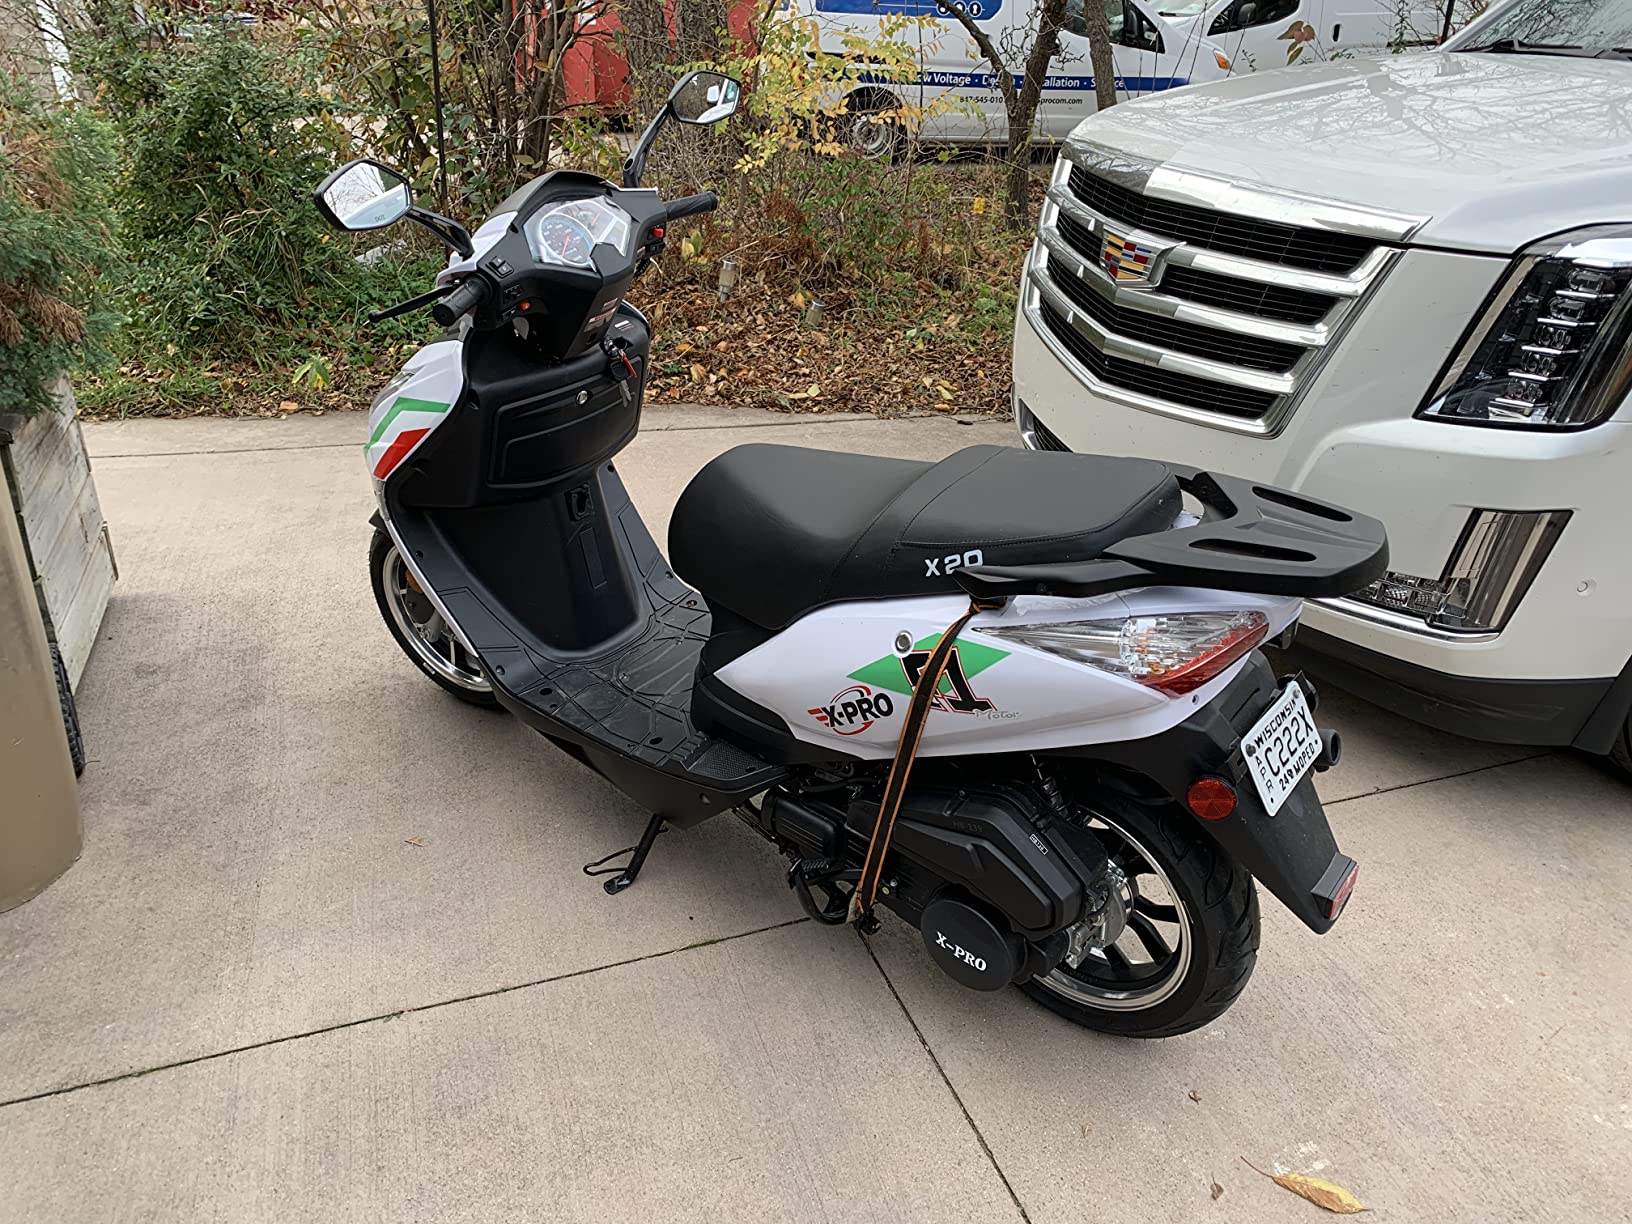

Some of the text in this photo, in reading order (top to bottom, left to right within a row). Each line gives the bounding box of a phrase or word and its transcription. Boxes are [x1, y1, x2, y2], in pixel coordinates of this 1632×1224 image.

[934, 73, 971, 86] Voltage
[924, 549, 983, 577] X20
[821, 693, 894, 728] X-PRO
[1254, 699, 1296, 749] WISCONSIN
[1265, 706, 1314, 777] C222X
[1293, 742, 1315, 776] MOPED
[936, 931, 987, 971] X-PRO
